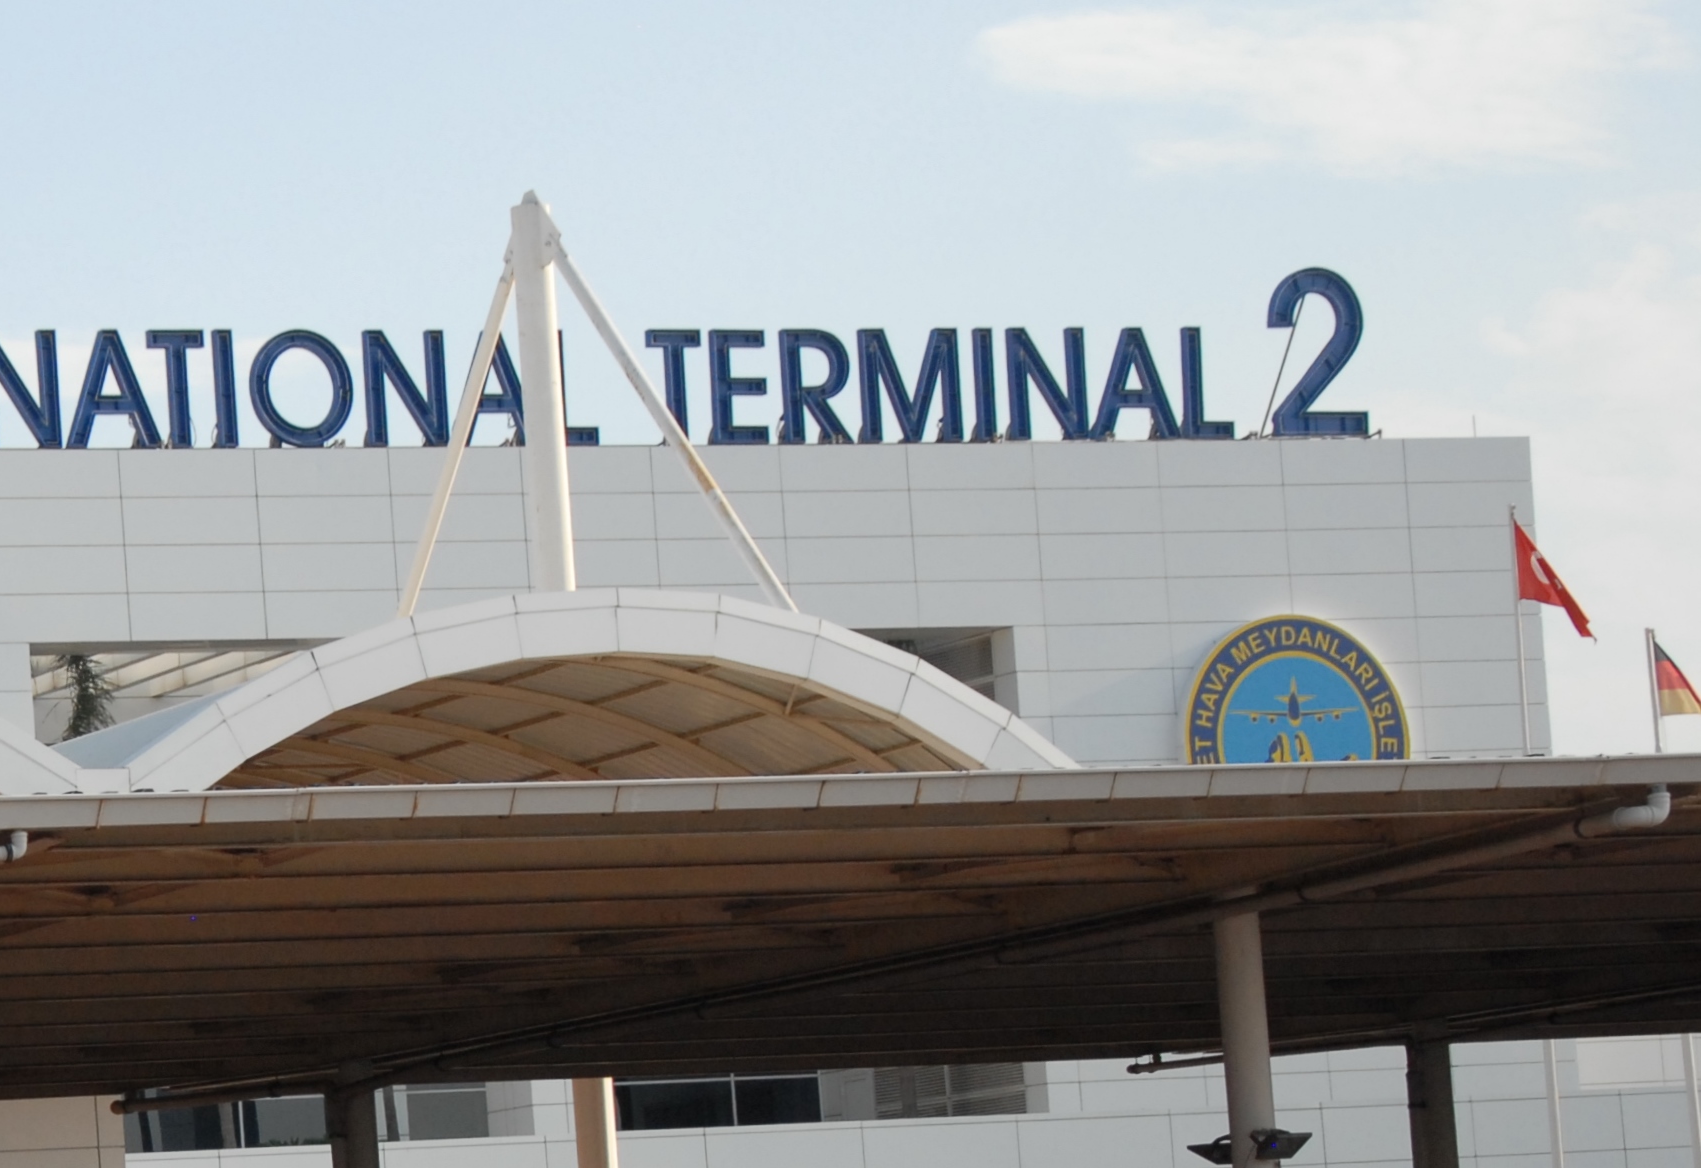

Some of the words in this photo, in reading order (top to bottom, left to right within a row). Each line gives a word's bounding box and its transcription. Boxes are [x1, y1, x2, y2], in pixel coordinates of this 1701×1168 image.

[645, 326, 1236, 447] TERMINAL
[1267, 267, 1371, 438] 2
[1195, 662, 1235, 728] HAVA
[1230, 625, 1379, 691] MEYDANLARI
[1372, 690, 1398, 762] İŞLE
